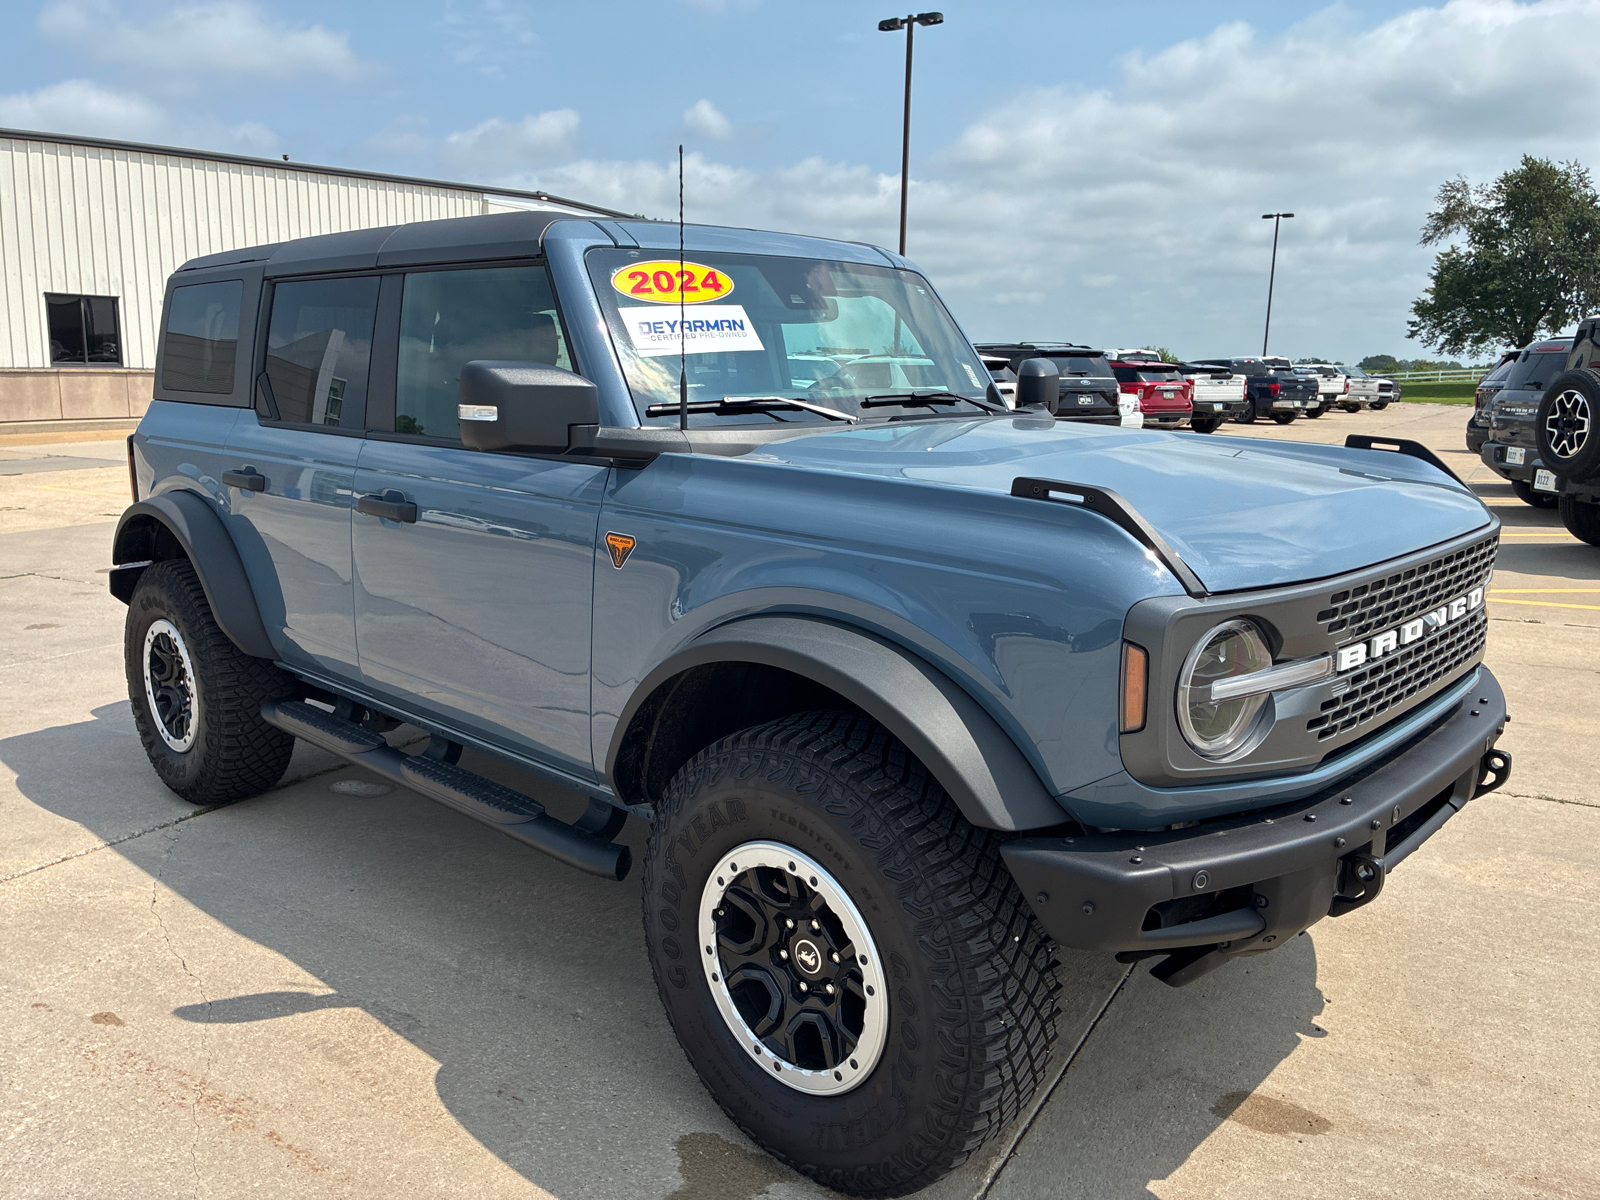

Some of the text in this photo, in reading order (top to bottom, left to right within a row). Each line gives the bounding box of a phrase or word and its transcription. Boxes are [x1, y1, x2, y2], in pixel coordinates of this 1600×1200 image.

[628, 270, 723, 294] 2024
[638, 319, 745, 335] DEYARMAN
[650, 331, 748, 341] CERTIFED PRE-OWNED
[1336, 587, 1484, 672] BRONCO
[769, 808, 853, 871] TERRITORY
[660, 797, 749, 990] GOODYEAR
